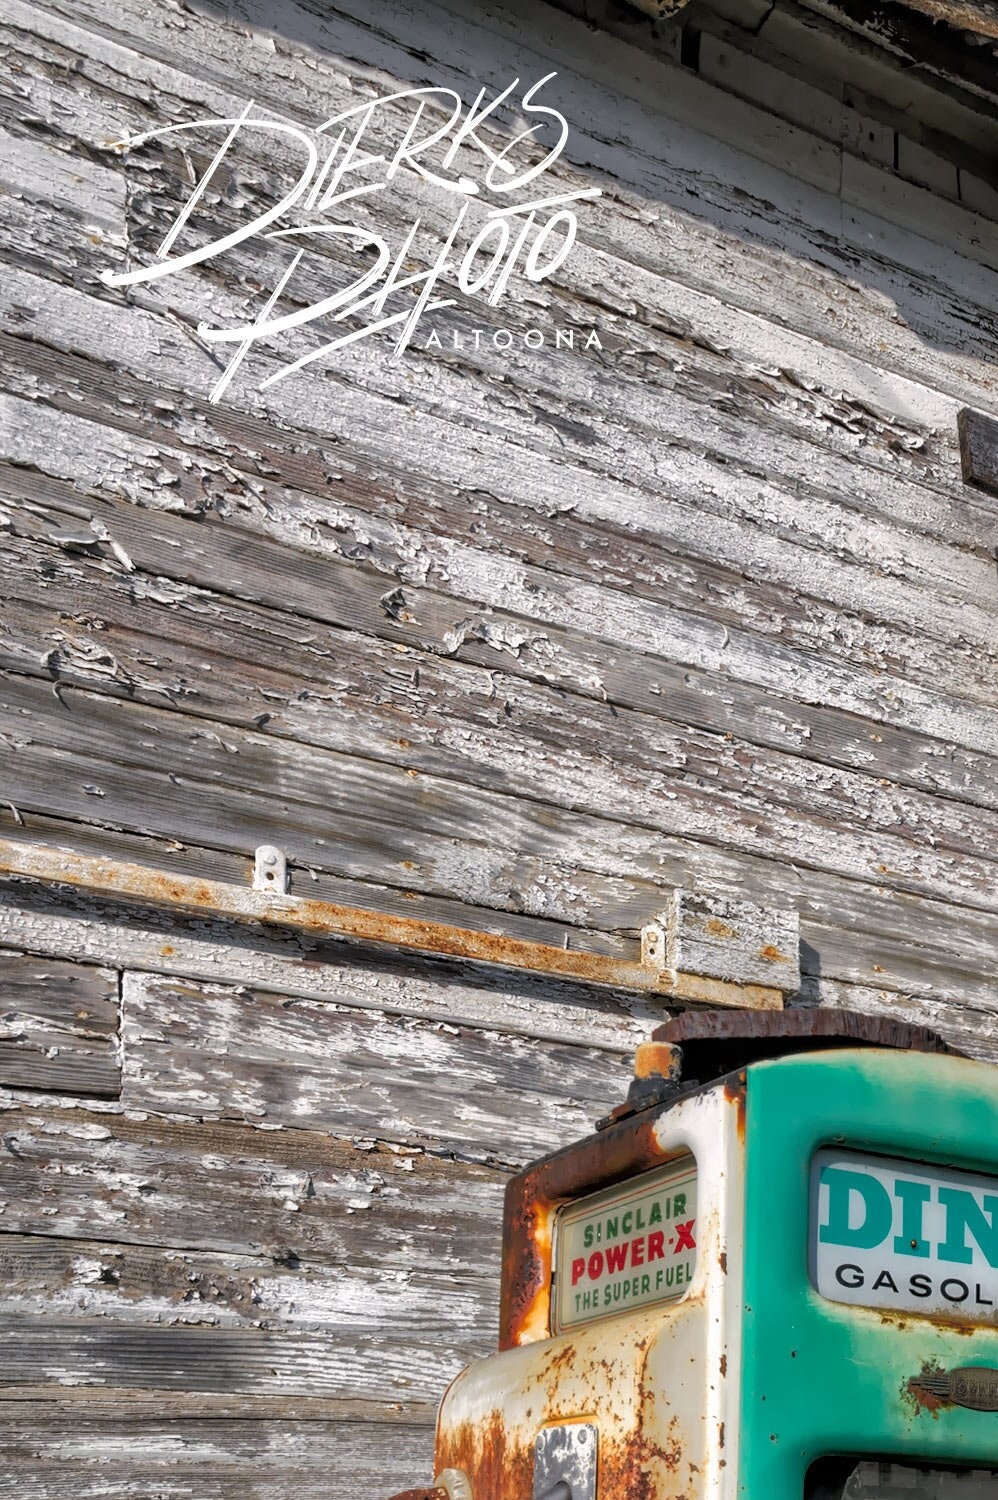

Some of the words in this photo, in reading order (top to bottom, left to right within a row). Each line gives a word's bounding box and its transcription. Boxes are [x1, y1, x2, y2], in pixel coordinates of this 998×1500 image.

[583, 1192, 688, 1249] SINCLAIR
[574, 1287, 599, 1313] THE
[603, 1273, 651, 1306] SUPER
[655, 1261, 693, 1291] FUEL
